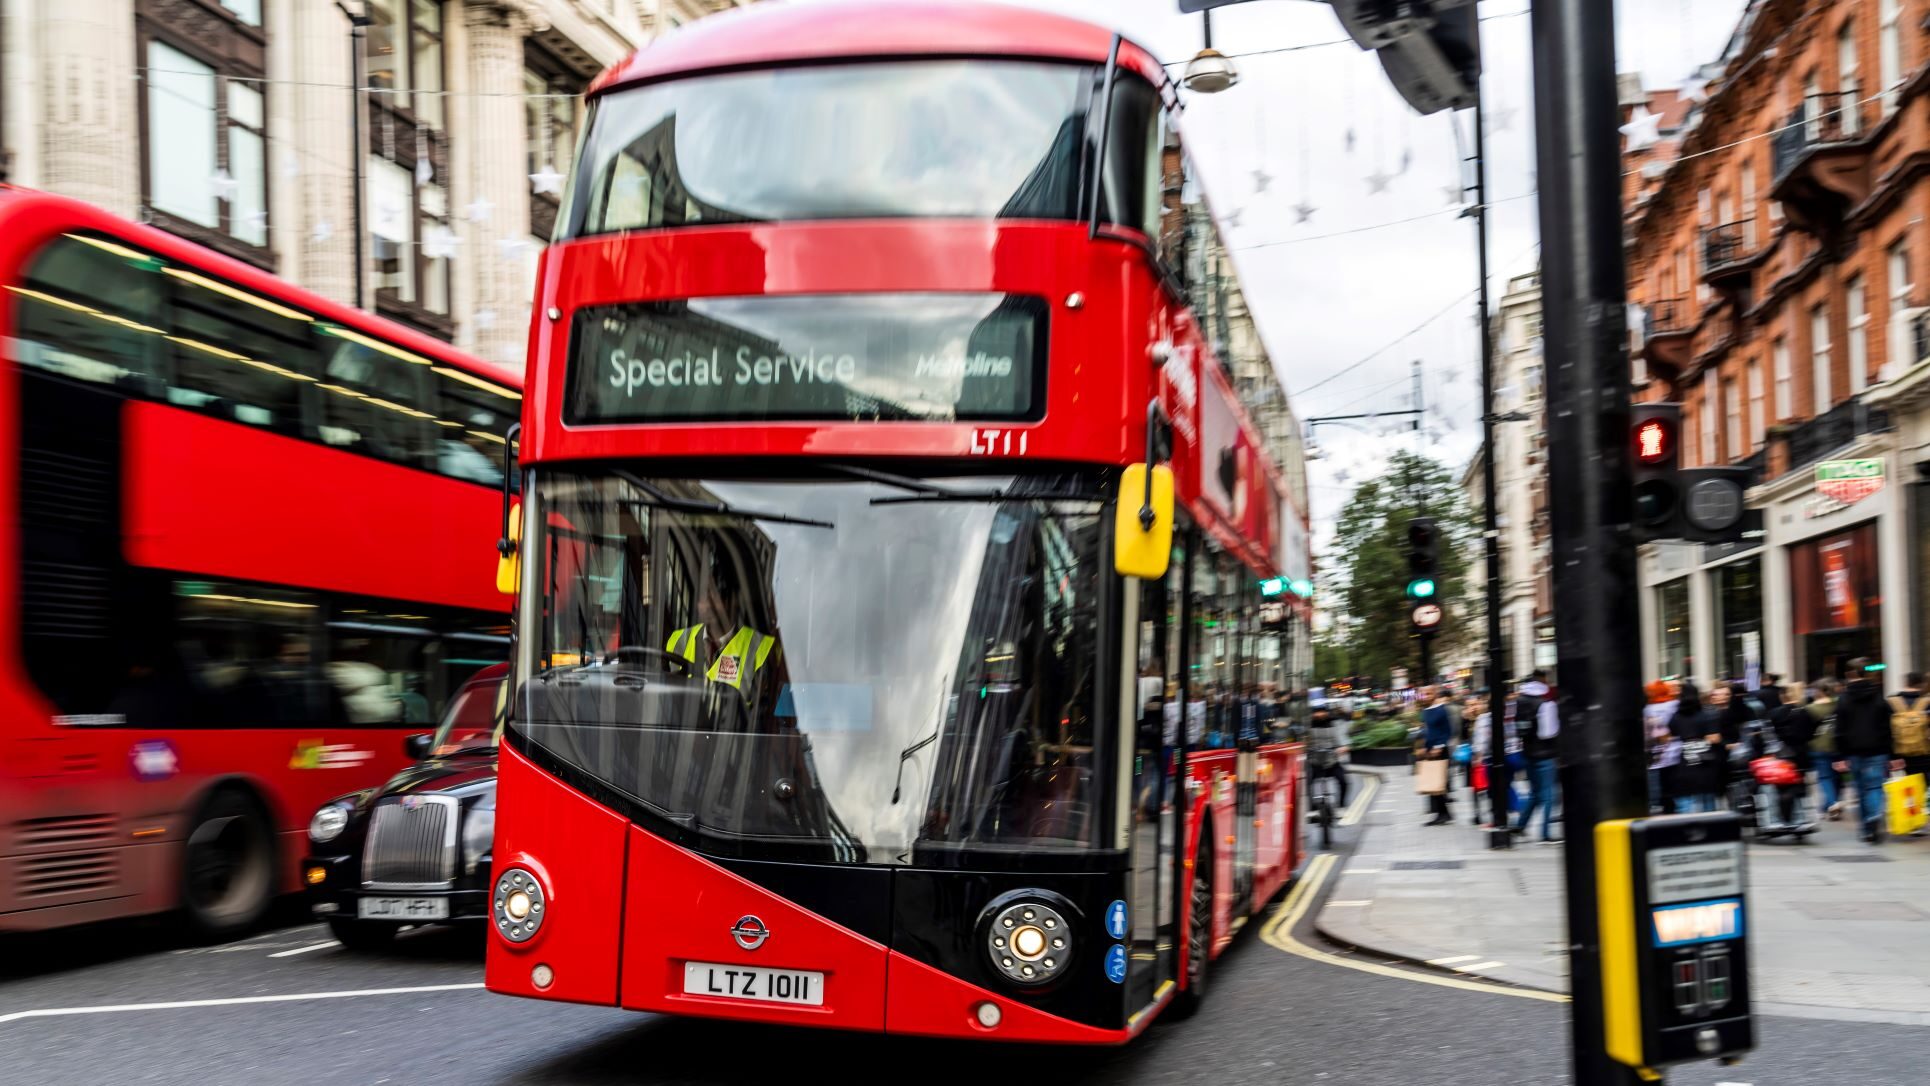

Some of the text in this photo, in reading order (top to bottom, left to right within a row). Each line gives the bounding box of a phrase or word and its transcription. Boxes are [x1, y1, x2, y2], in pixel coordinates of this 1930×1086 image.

[610, 345, 855, 397] Special Service
[971, 429, 1027, 456] LT11
[708, 968, 808, 1000] LTZ 1011
